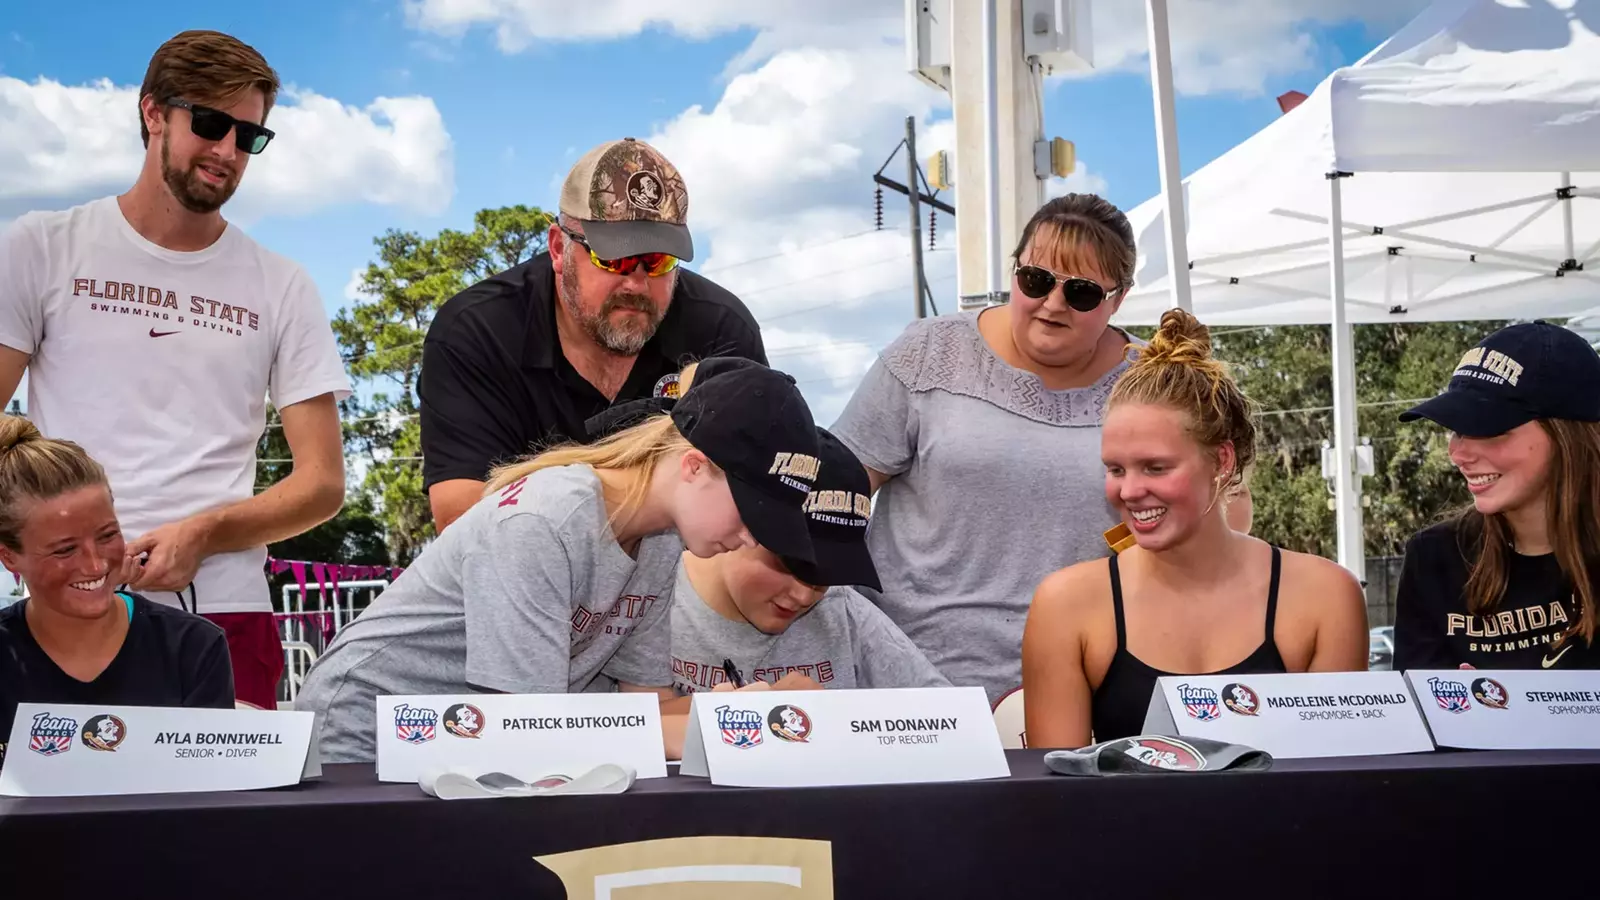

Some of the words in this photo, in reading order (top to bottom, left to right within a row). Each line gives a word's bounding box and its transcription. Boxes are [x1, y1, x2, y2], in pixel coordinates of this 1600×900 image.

[73, 278, 178, 310] FLORIDA
[190, 295, 259, 331] STATE
[91, 303, 169, 321] SWIMMING
[193, 319, 242, 337] DIVING
[1482, 349, 1524, 387] STATE
[1447, 600, 1568, 638] FLORIDA
[1469, 632, 1561, 653] SWIMMING
[753, 660, 834, 684] STTE
[1177, 683, 1218, 700] Team
[1428, 677, 1467, 693] Team
[1267, 695, 1337, 708] MADELEINE
[1339, 693, 1406, 706] MCDONALD
[1432, 690, 1468, 698] IMPACT
[1525, 691, 1594, 702] STEPHANIE
[394, 703, 438, 720] Team
[715, 705, 762, 723] Team
[1299, 710, 1354, 721] SOPHOMORE
[1362, 708, 1386, 719] BACK
[1548, 705, 1600, 715] SOPHOMORE
[32, 712, 78, 731] Team
[502, 717, 563, 730] PATRICK
[566, 715, 646, 729] BUTKOVICH
[718, 721, 763, 729] IMPACT
[850, 719, 882, 733] SAM
[886, 717, 958, 732] DONAWAY
[31, 730, 76, 738] IMPACT
[154, 732, 192, 745] AYLA
[196, 732, 283, 745] BONNIWELL
[877, 735, 896, 745] TOP
[899, 734, 939, 745] RECRUIT
[175, 748, 215, 758] SENIOR
[226, 748, 257, 758] DIVER
